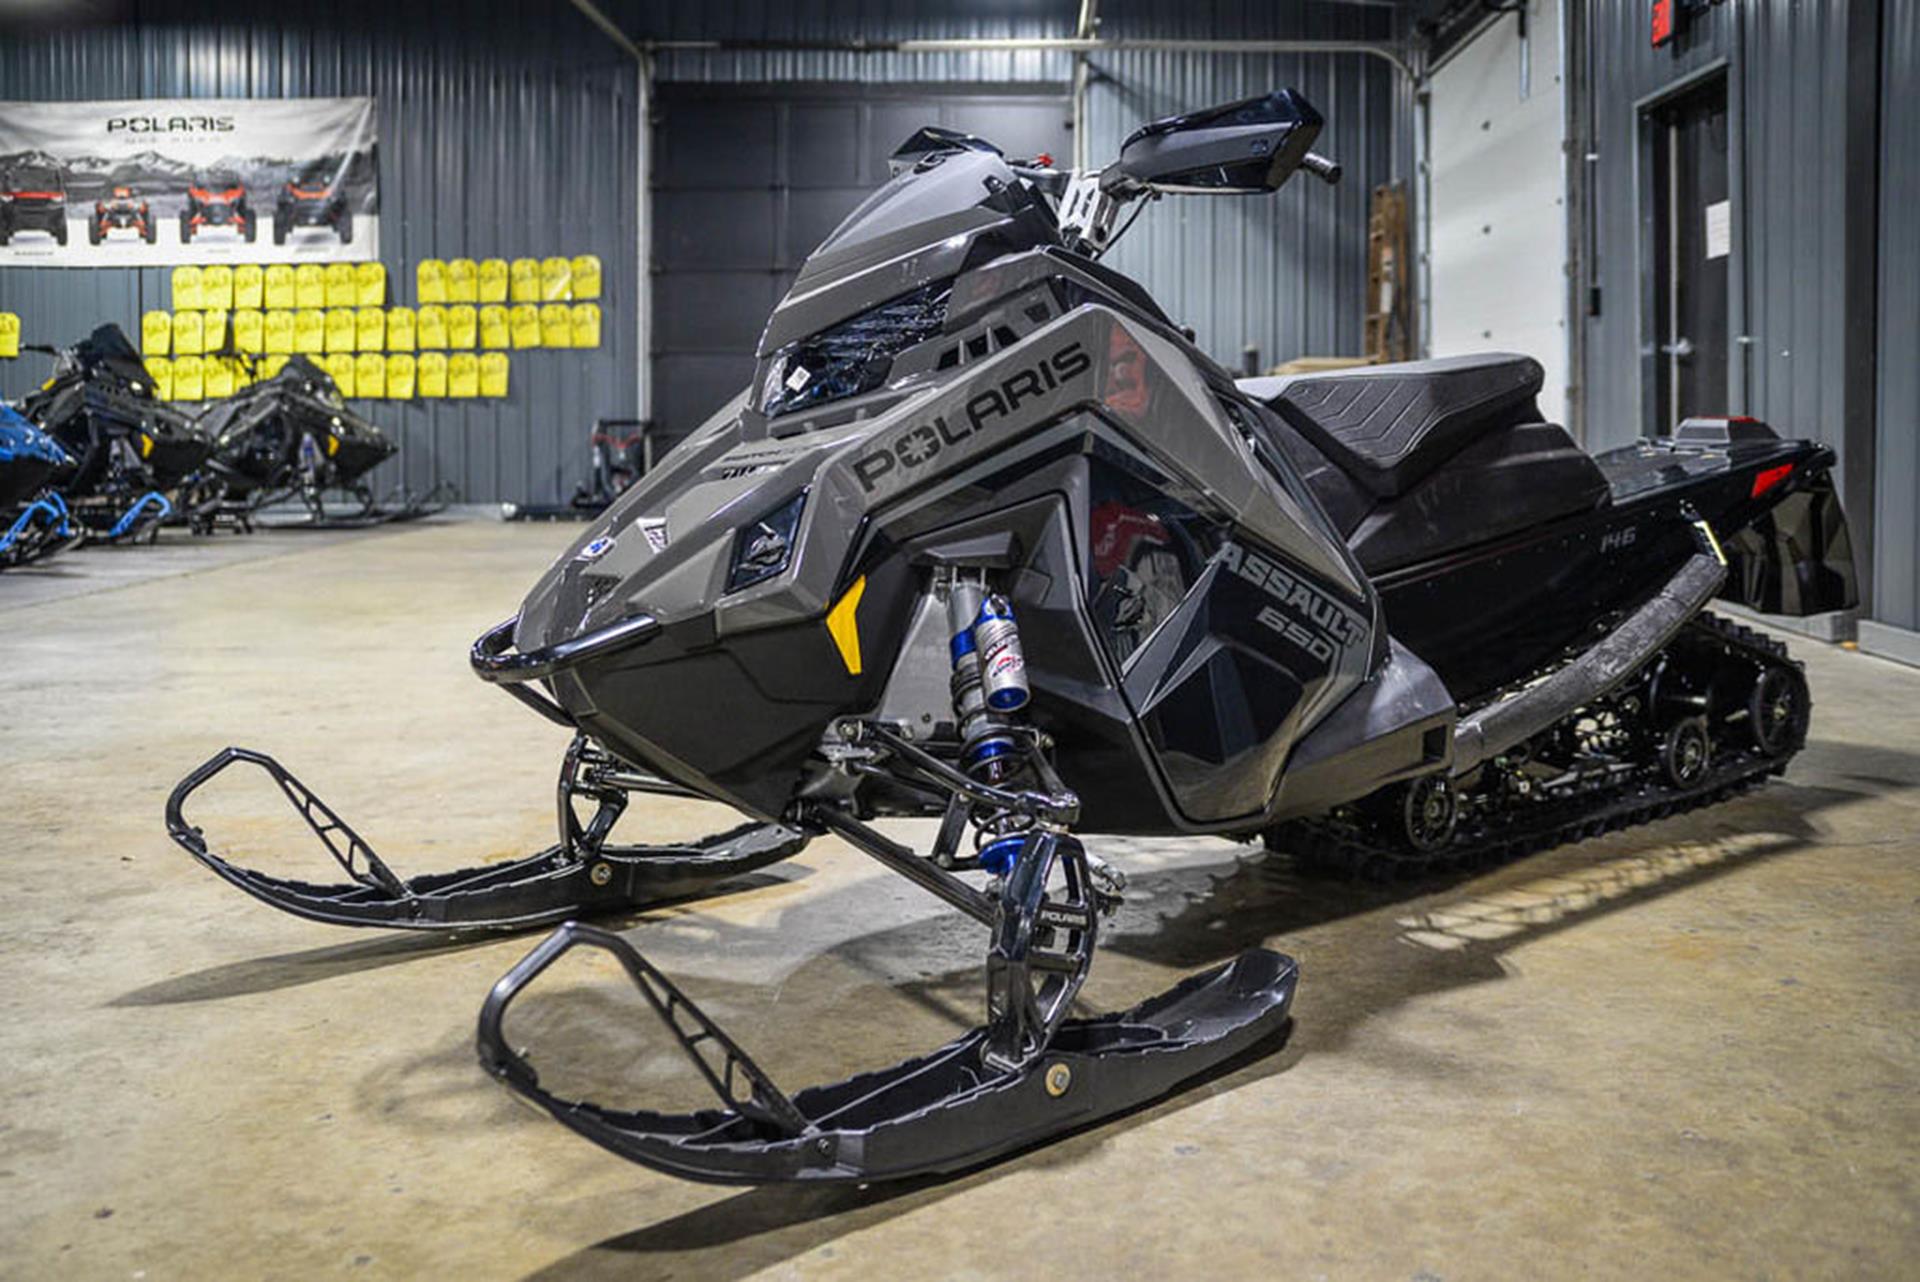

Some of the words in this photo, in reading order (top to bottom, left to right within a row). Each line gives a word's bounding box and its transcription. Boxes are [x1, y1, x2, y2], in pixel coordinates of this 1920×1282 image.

[107, 117, 235, 132] POLARIS
[853, 342, 1091, 493] POLARIS
[1600, 526, 1636, 552] 146
[1208, 541, 1366, 648] ASSAULT
[1256, 605, 1334, 663] 650
